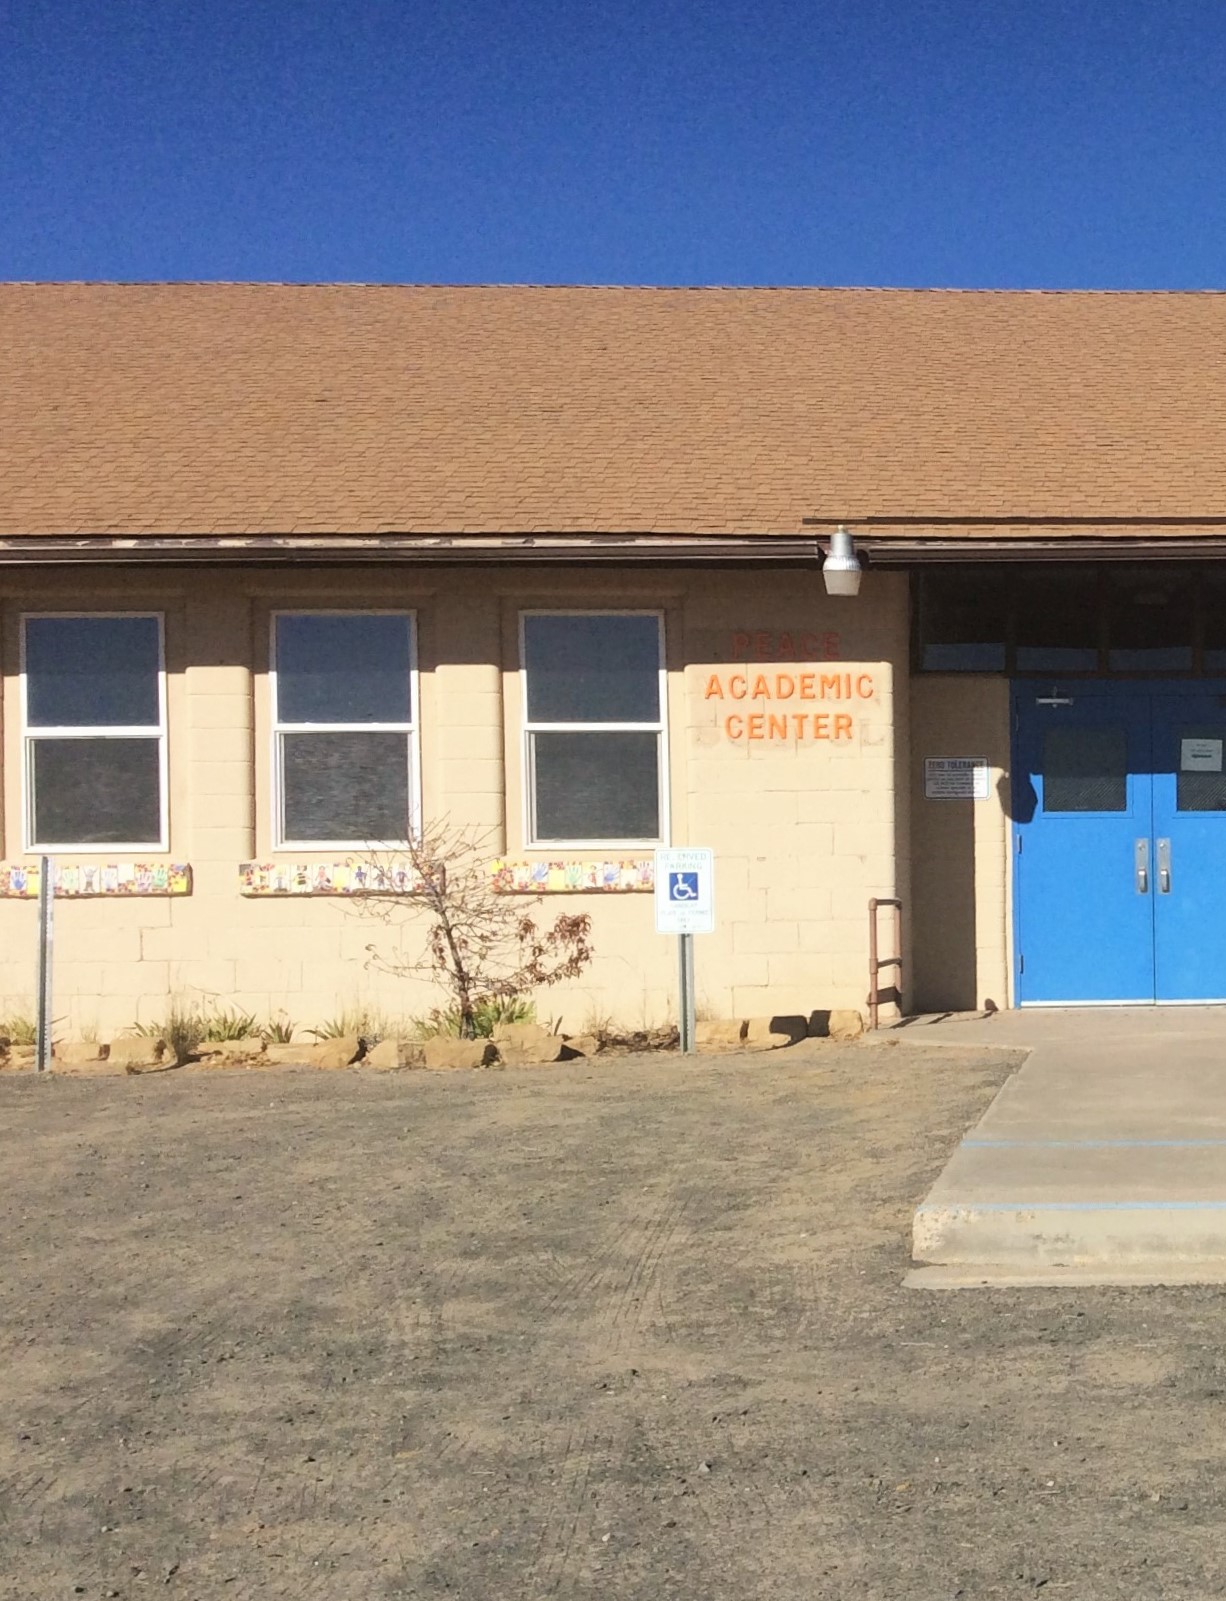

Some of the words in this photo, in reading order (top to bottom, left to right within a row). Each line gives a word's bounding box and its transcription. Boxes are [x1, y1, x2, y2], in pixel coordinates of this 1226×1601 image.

[731, 631, 841, 661] PEACE
[705, 673, 875, 700] ACADEMIC
[725, 713, 854, 740] CENTER
[660, 852, 707, 861] REERVED
